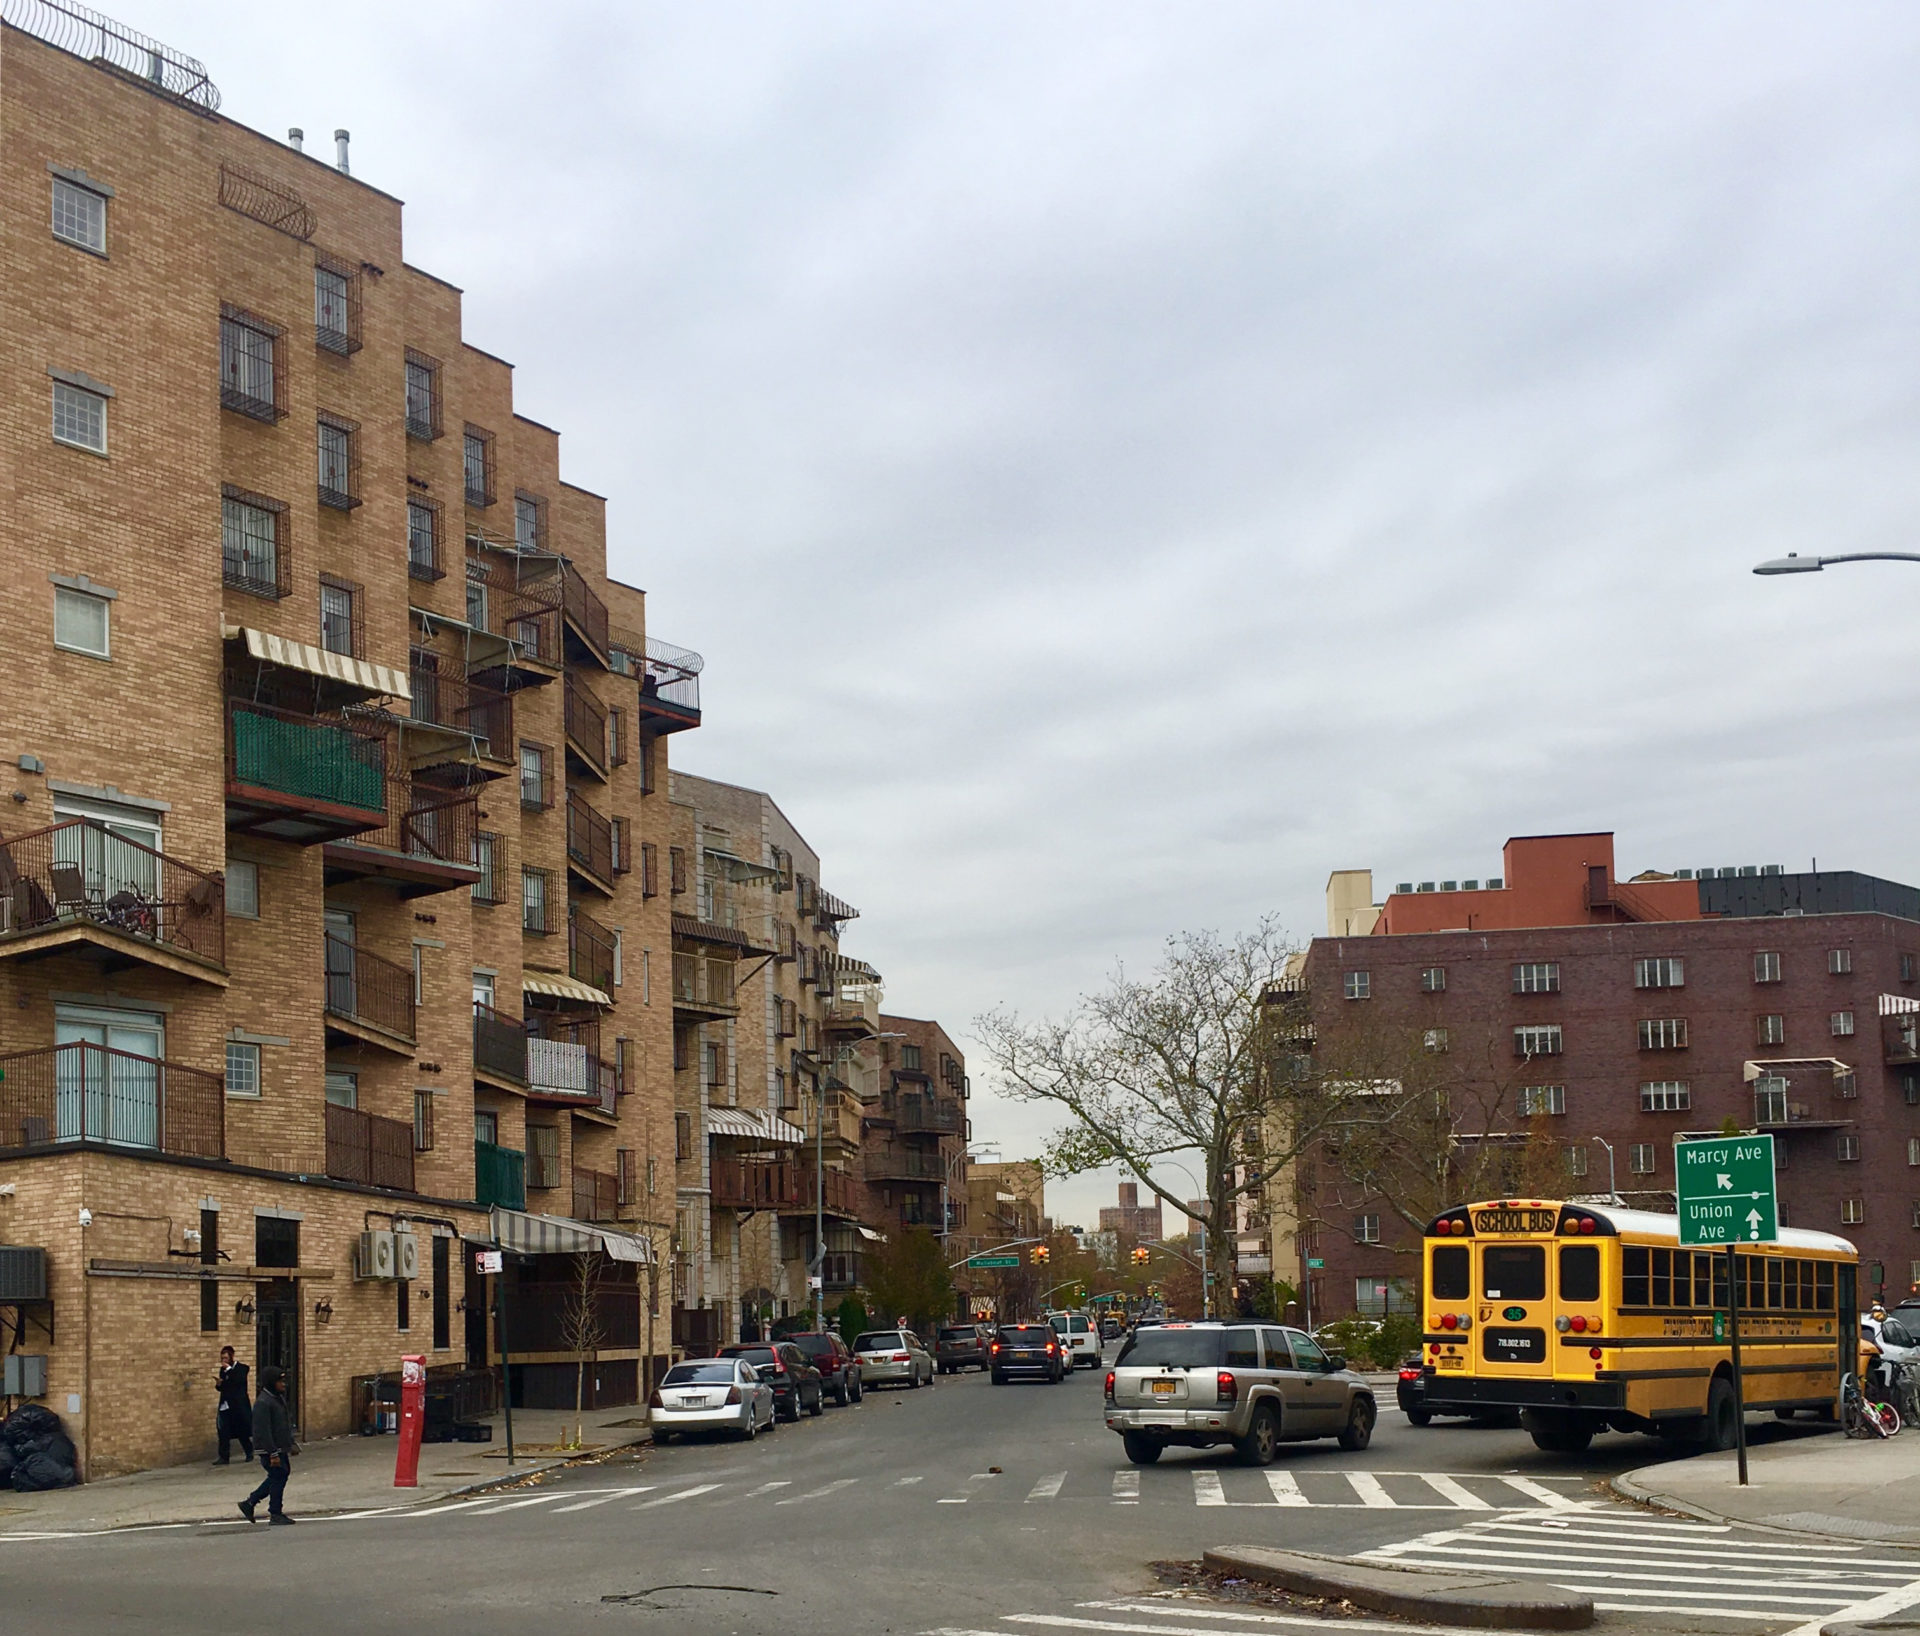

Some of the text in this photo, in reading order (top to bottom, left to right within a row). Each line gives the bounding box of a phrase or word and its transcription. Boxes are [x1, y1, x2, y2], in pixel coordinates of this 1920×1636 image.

[1686, 1146, 1762, 1166] Marcy Ave
[1690, 1202, 1733, 1219] Union
[1480, 1210, 1553, 1231] SCHOOL BUS
[1699, 1224, 1725, 1239] Ave
[1507, 1308, 1522, 1320] 35
